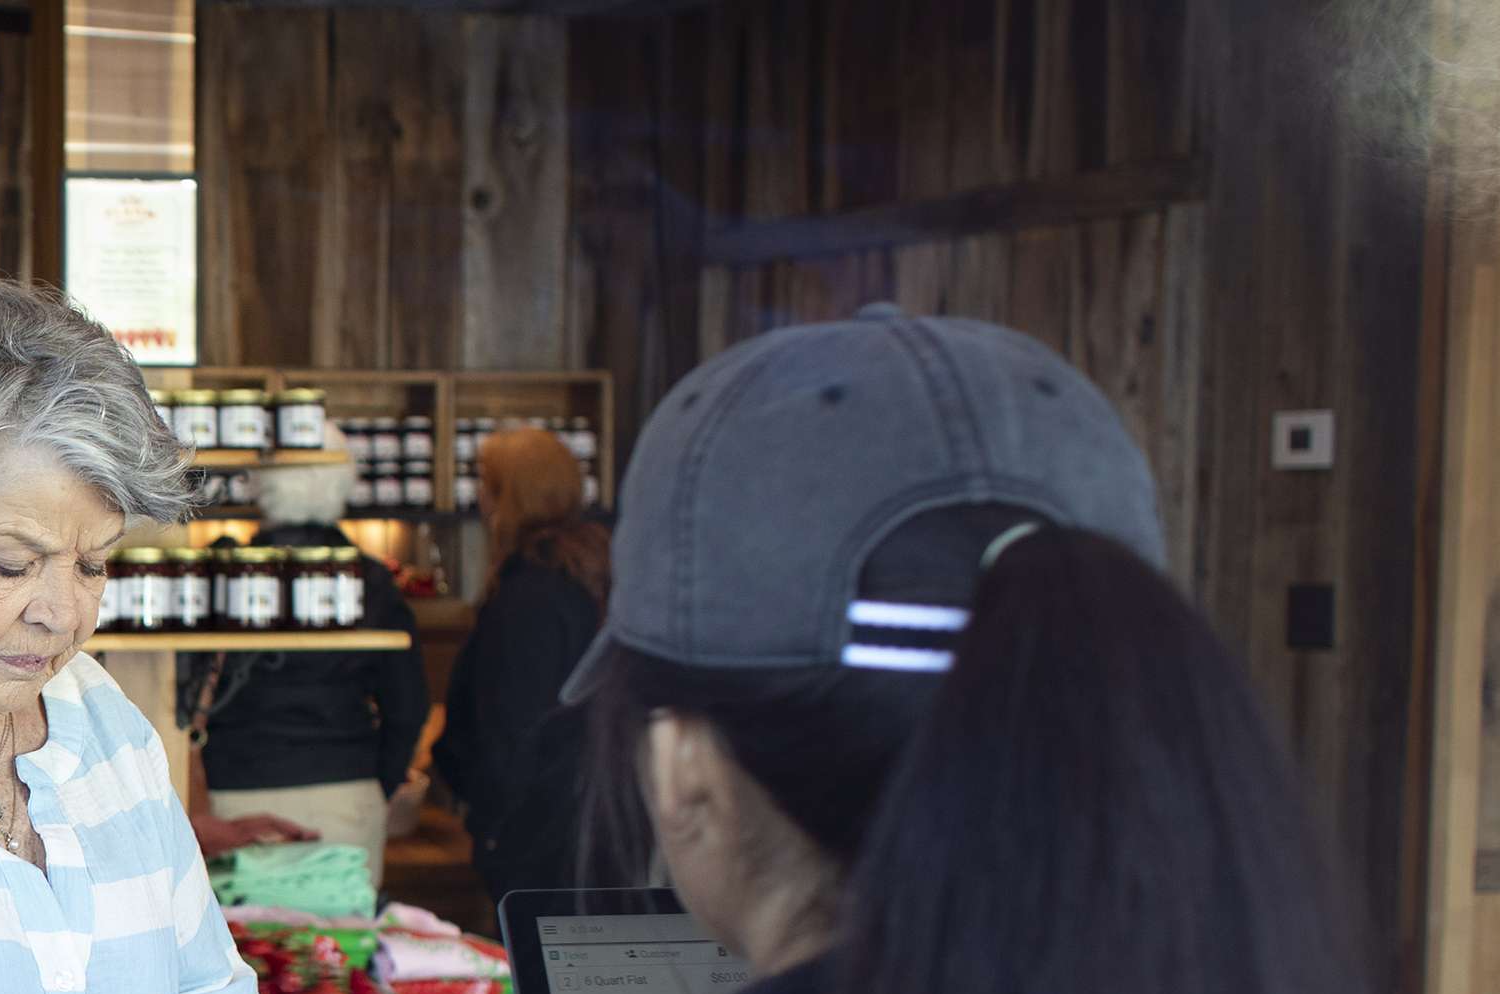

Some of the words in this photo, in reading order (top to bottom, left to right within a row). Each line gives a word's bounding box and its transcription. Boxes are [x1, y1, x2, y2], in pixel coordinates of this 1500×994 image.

[564, 977, 572, 987] 2
[594, 976, 625, 986] Quart
[627, 975, 648, 985] Flat
